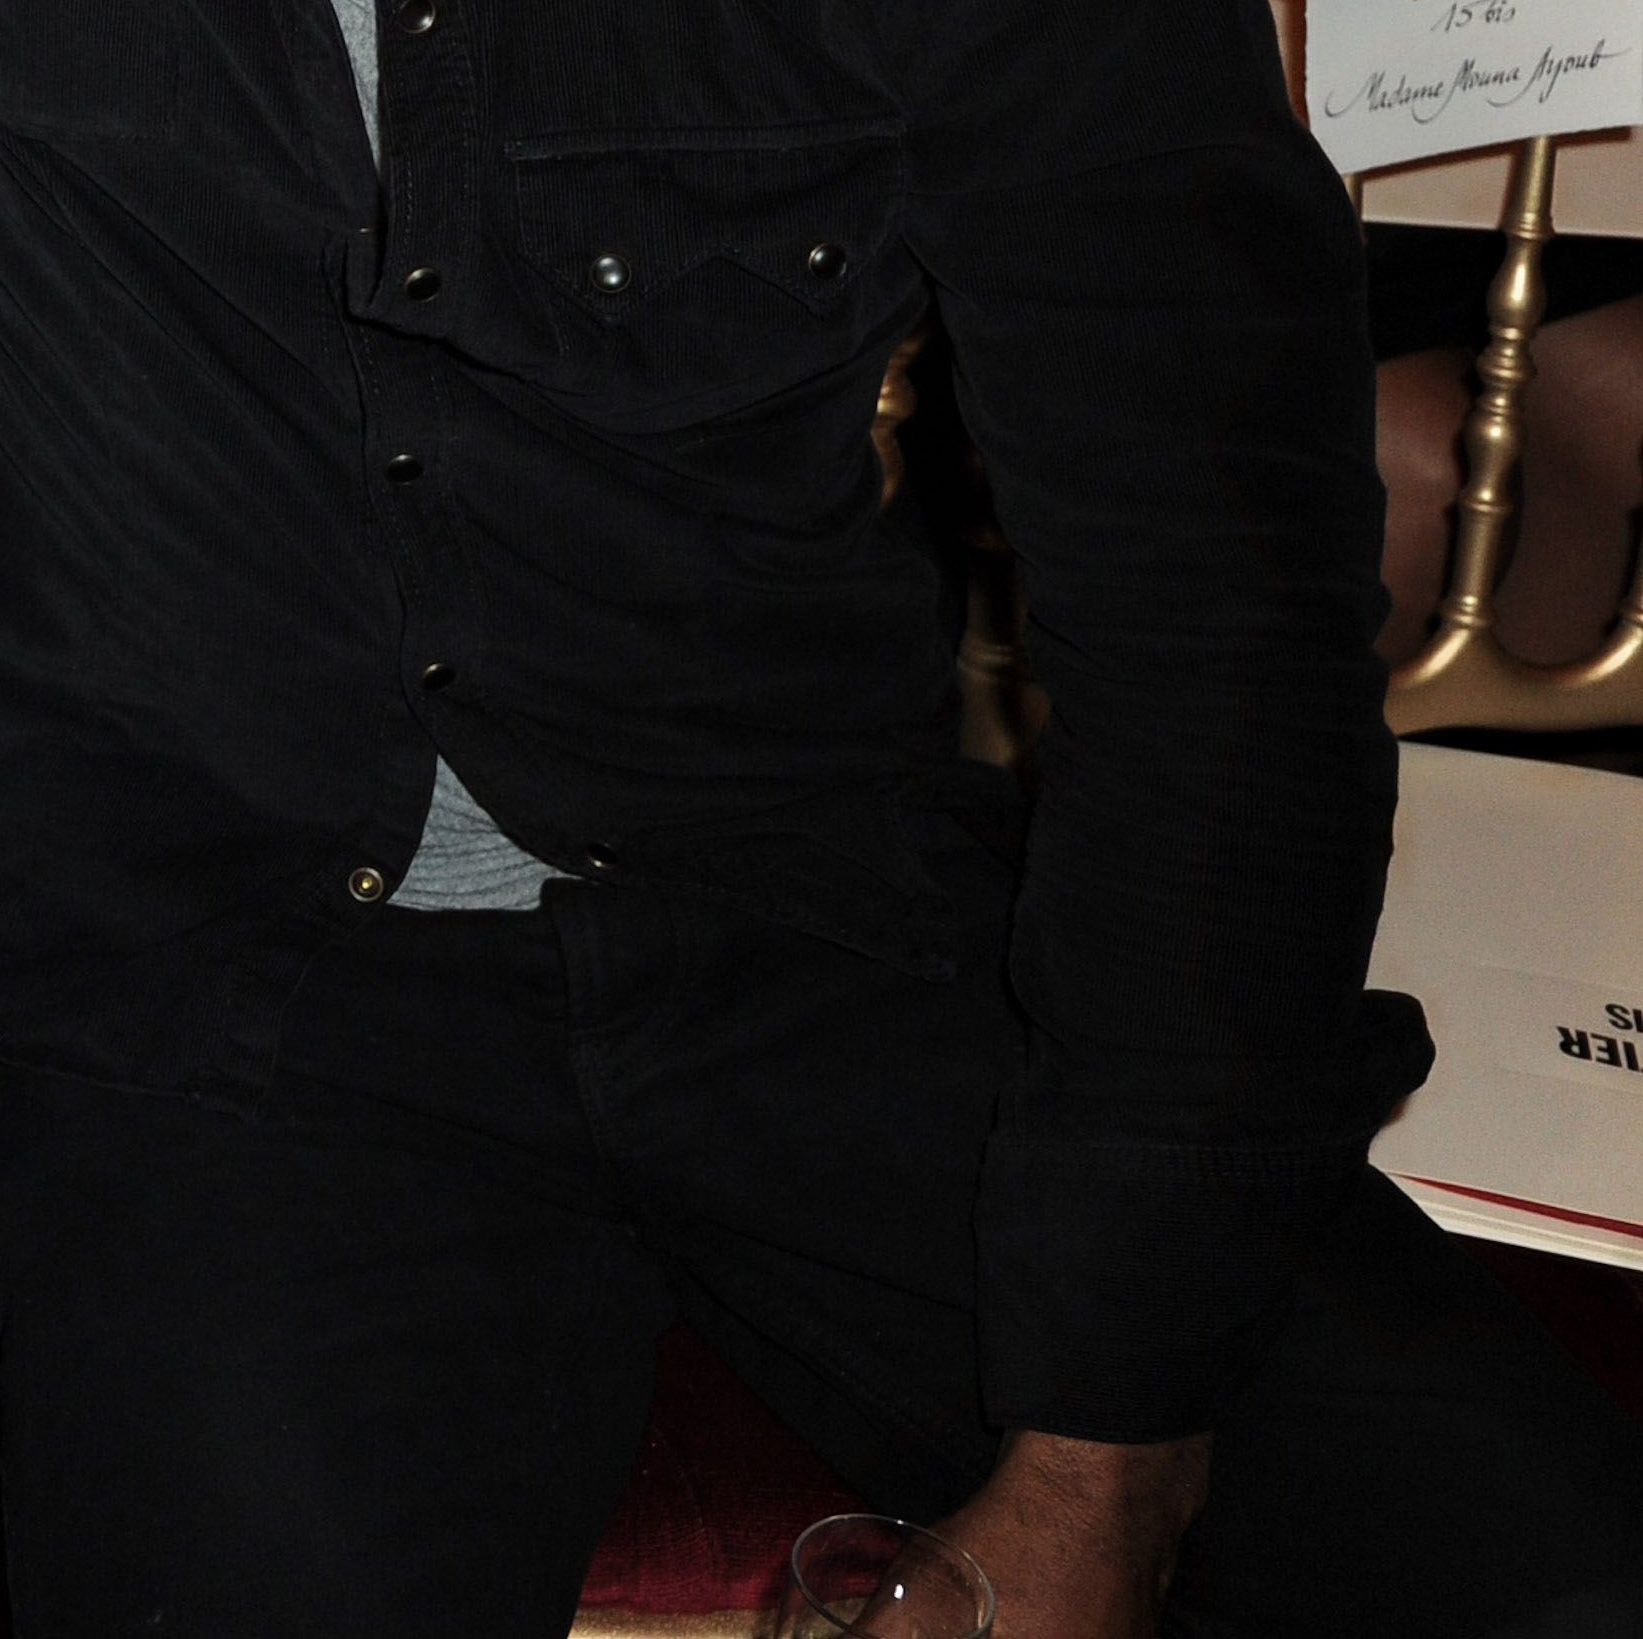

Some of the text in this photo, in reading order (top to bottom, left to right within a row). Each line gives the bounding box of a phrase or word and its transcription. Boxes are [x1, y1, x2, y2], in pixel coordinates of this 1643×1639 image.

[1324, 70, 1444, 118] Madame
[1487, 39, 1632, 108] Ayoub
[1556, 1025, 1643, 1073] IER
